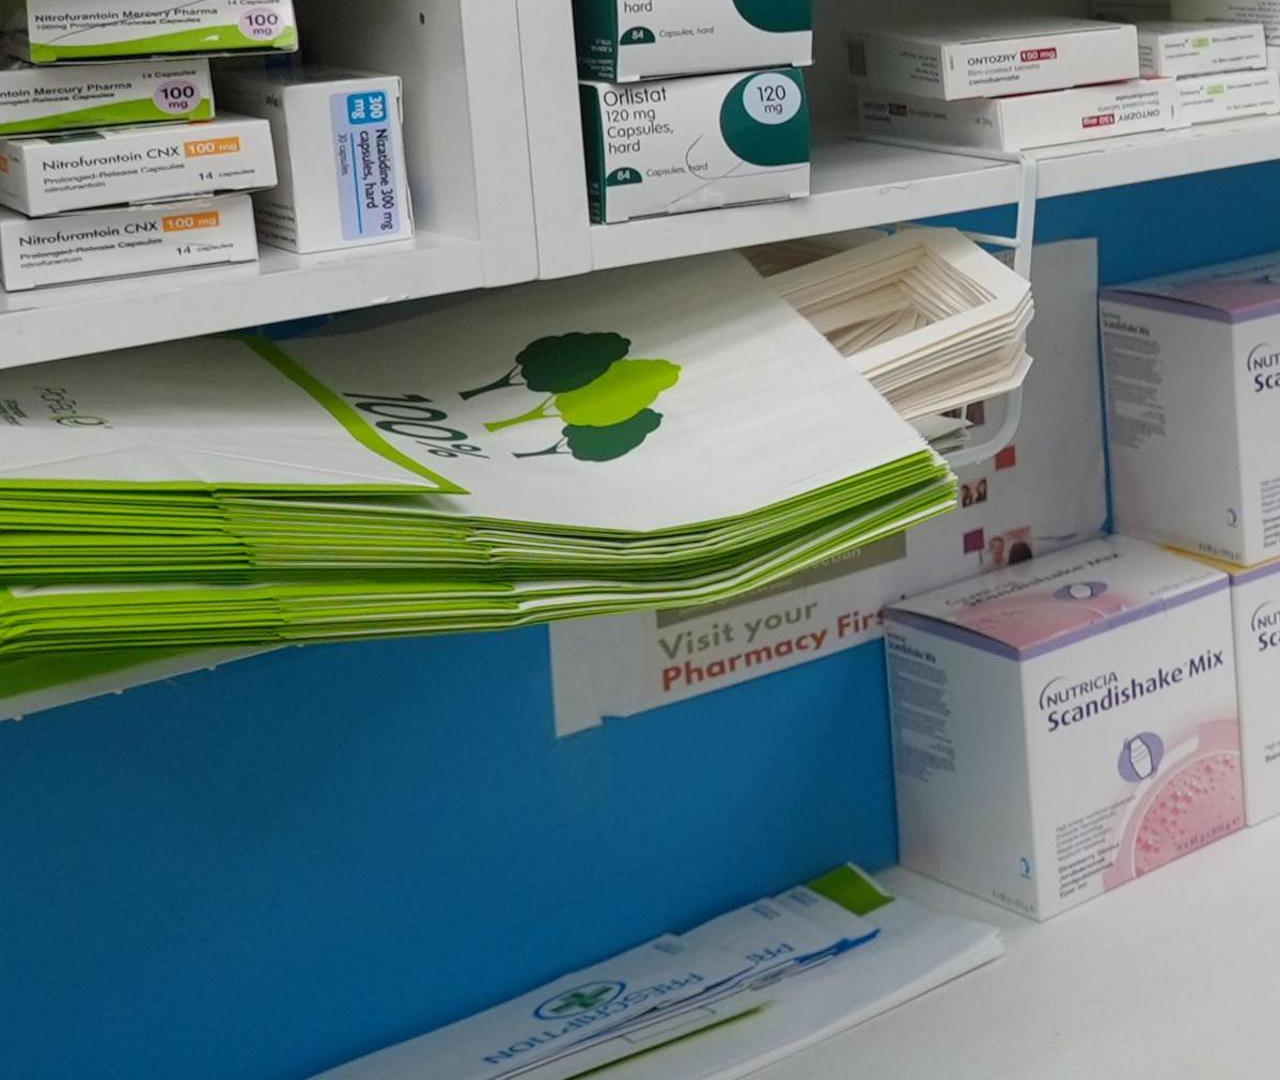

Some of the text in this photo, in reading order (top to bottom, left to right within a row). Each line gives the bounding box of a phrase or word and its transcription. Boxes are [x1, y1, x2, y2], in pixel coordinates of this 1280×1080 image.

[623, 0, 653, 14] hard
[34, 7, 218, 23] Nitrofurantoin Mercury Pharma
[245, 14, 278, 26] 100
[253, 28, 272, 36] mg
[632, 30, 644, 40] 84
[967, 50, 1037, 66] ONTOZRY 150
[968, 74, 1020, 86] cenobamate
[34, 84, 84, 96] Mercury
[87, 82, 132, 91] Pharma
[161, 86, 195, 99] 100
[603, 86, 667, 107] Orlistat
[757, 86, 786, 102] 120
[168, 99, 188, 110] mg
[369, 96, 384, 119] 300
[764, 102, 783, 115] mg
[605, 108, 656, 122] 120 mg
[1119, 109, 1160, 122] ONTOZRY
[607, 122, 674, 139] Capsules,
[608, 140, 640, 155] hard
[43, 143, 215, 171] Nitrofurantoin CNX 100
[198, 172, 213, 180] 14
[357, 130, 378, 209] capsules, hard
[375, 129, 394, 209] Nizatidine 300
[616, 170, 630, 180] 84
[19, 217, 193, 247] Nitrofurantoin CNX 100
[176, 246, 191, 256] 14
[342, 391, 490, 459] 100%
[658, 602, 818, 659] Visit your
[662, 607, 886, 693] Pharmacy Firs
[1046, 672, 1118, 709] NUTRICIA
[1047, 649, 1224, 732] Scandishake Mix
